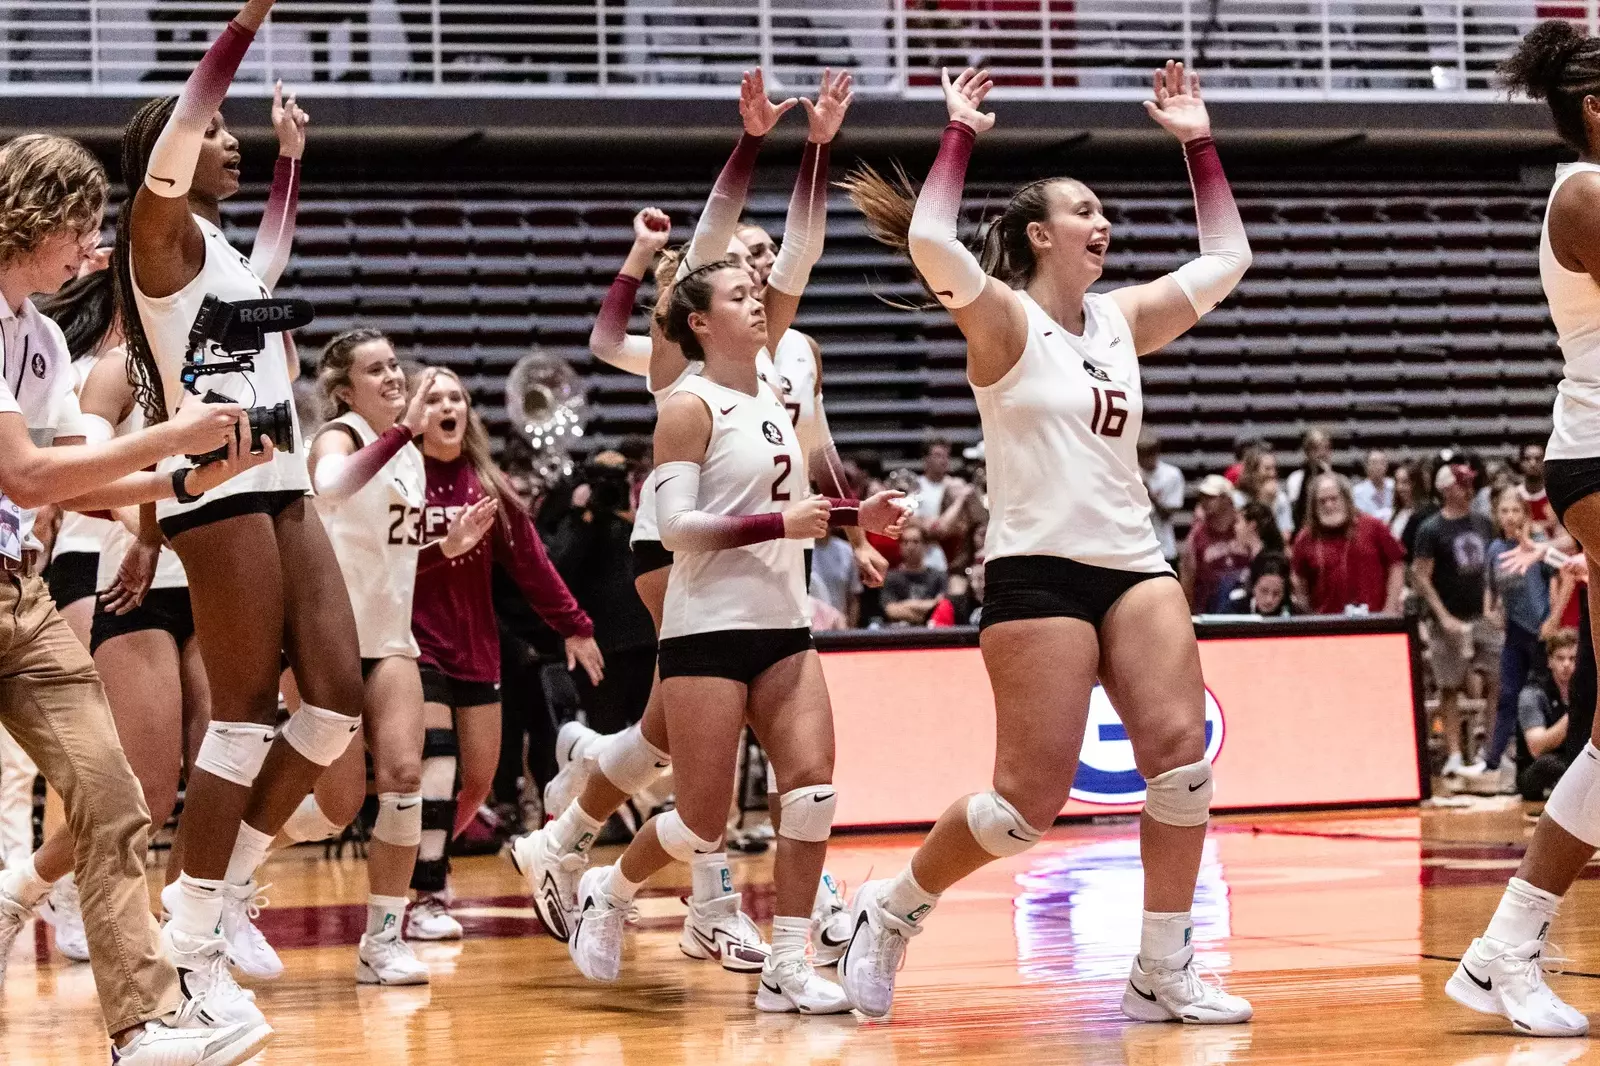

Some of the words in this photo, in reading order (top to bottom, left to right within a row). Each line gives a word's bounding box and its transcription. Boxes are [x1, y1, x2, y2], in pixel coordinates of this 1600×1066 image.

[240, 305, 294, 323] RØDE
[1091, 387, 1128, 437] 16
[771, 454, 791, 501] 2
[388, 504, 420, 545] 23
